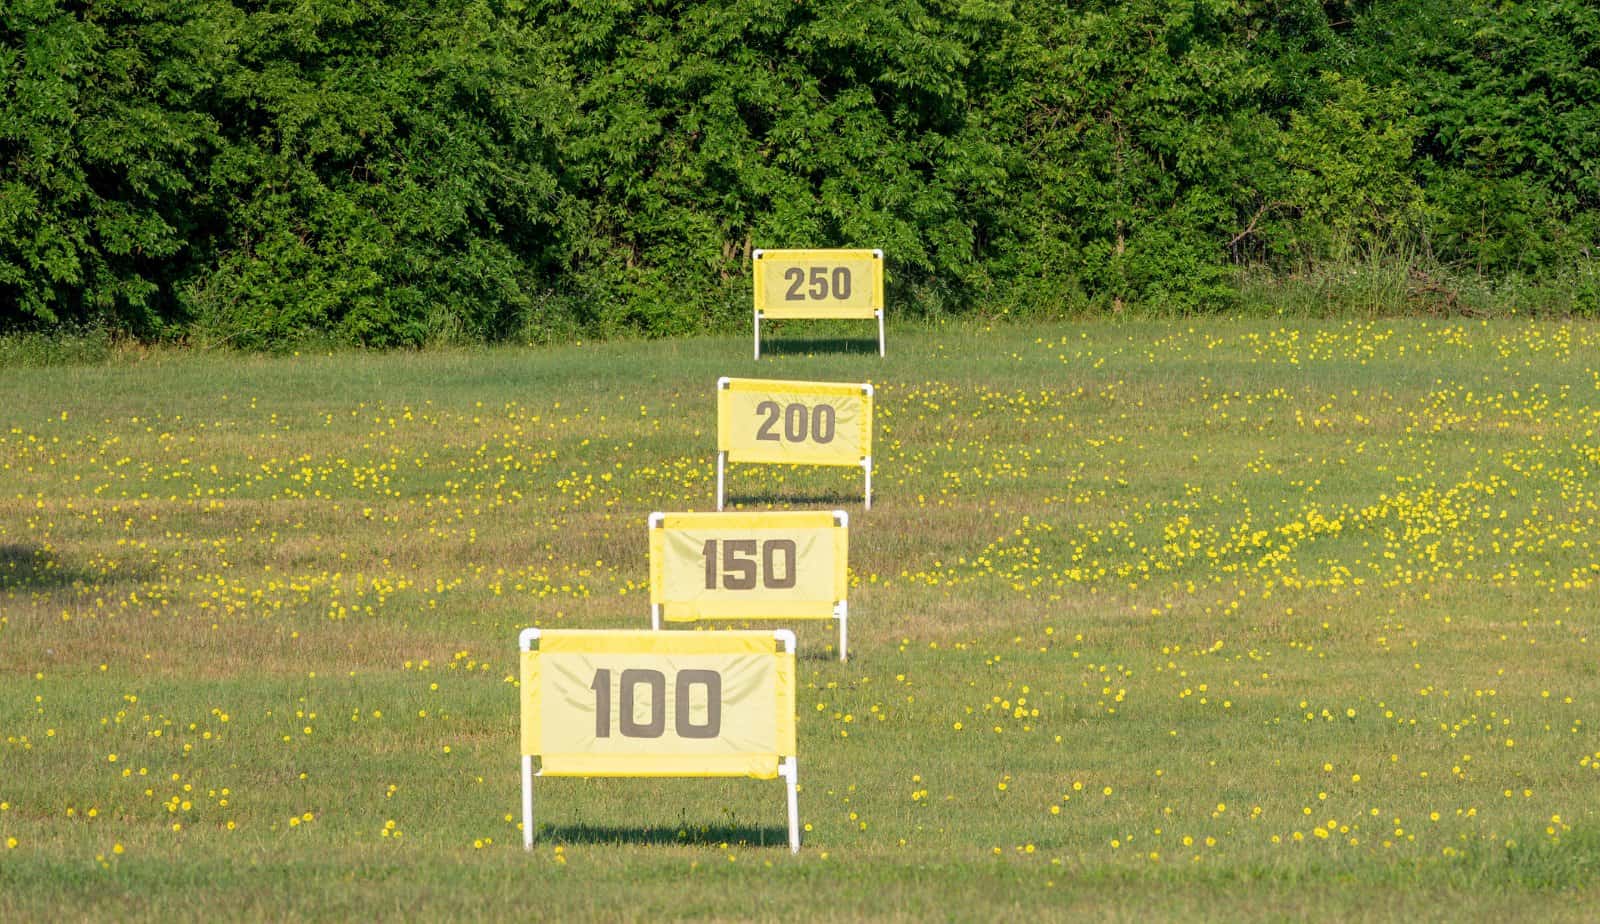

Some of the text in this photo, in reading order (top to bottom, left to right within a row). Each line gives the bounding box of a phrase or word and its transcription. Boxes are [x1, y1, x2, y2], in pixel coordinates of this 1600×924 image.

[784, 267, 852, 301] 250
[756, 401, 836, 444] 200
[702, 539, 797, 590] 150
[590, 668, 722, 739] 100
